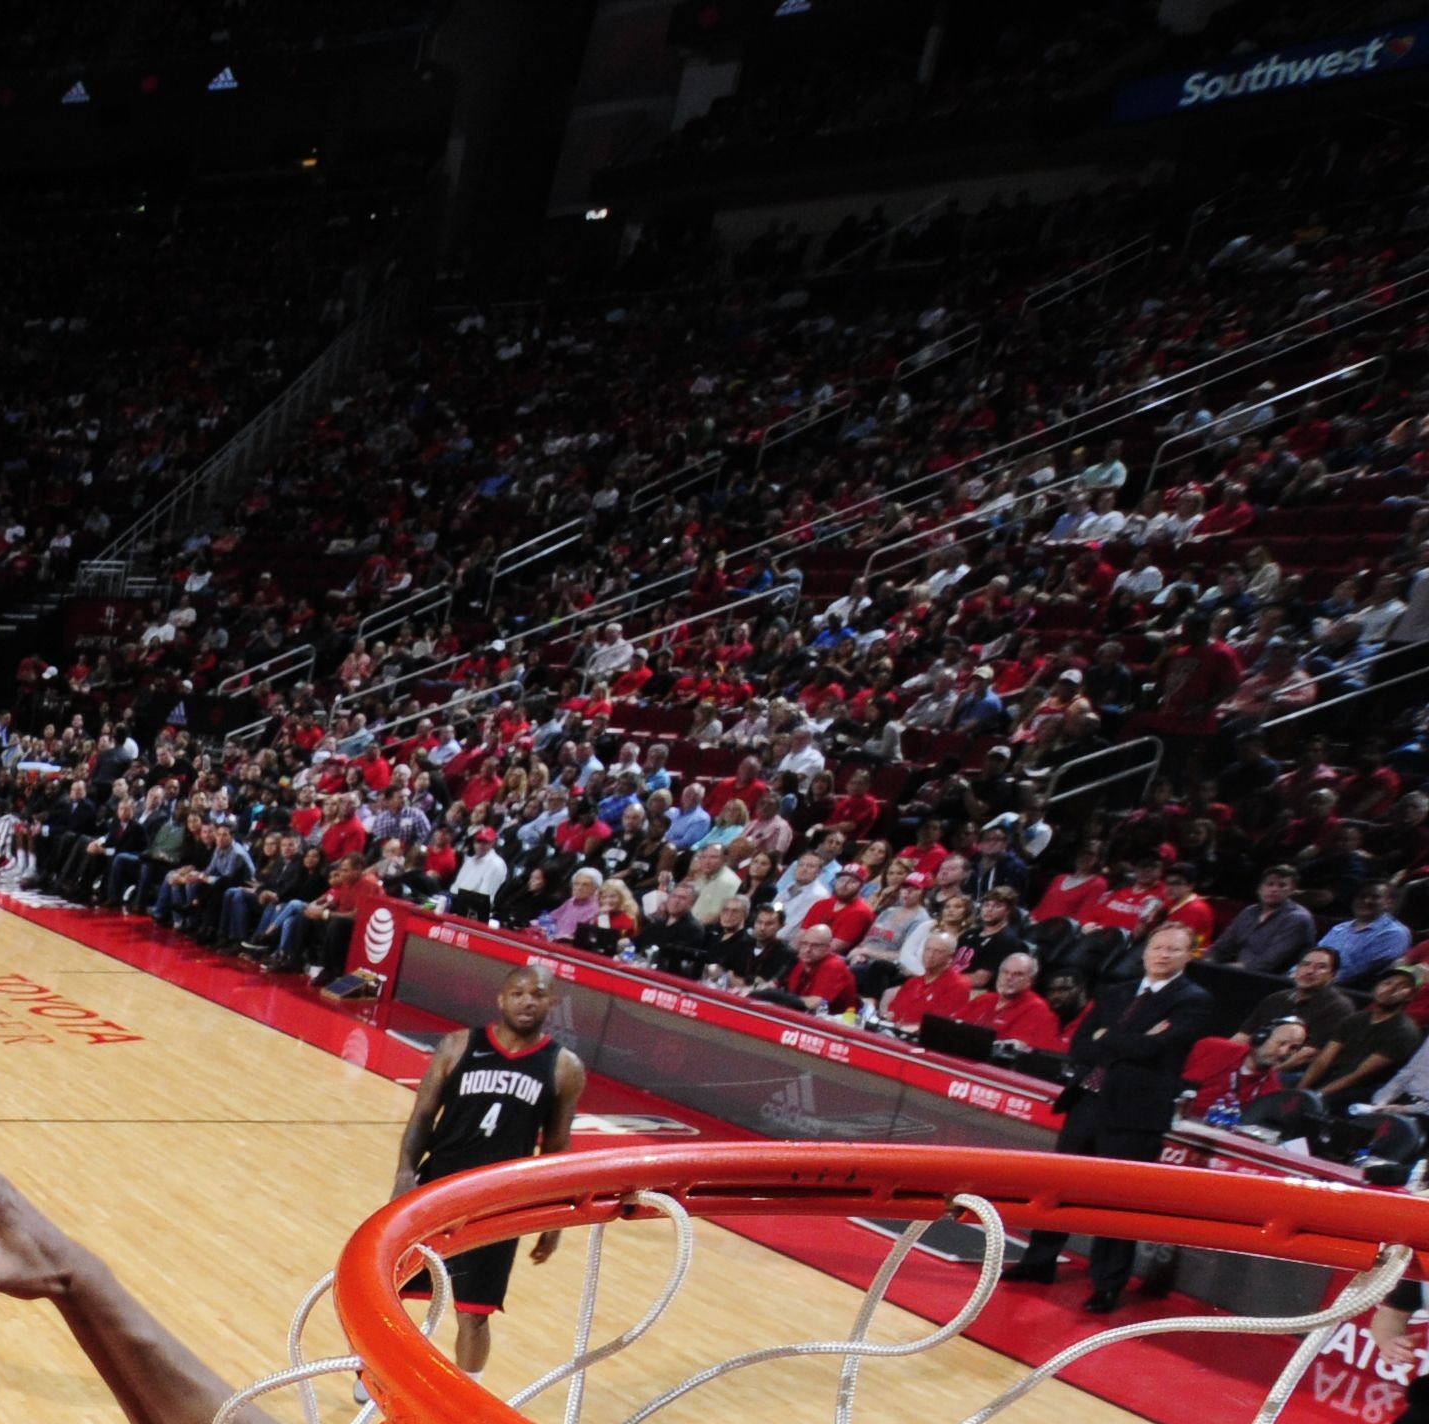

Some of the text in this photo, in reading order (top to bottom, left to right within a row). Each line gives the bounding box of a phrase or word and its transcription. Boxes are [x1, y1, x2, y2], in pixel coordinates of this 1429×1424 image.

[1178, 34, 1386, 108] Southwest
[459, 1069, 544, 1106] HOUSTON
[479, 1102, 503, 1138] 4
